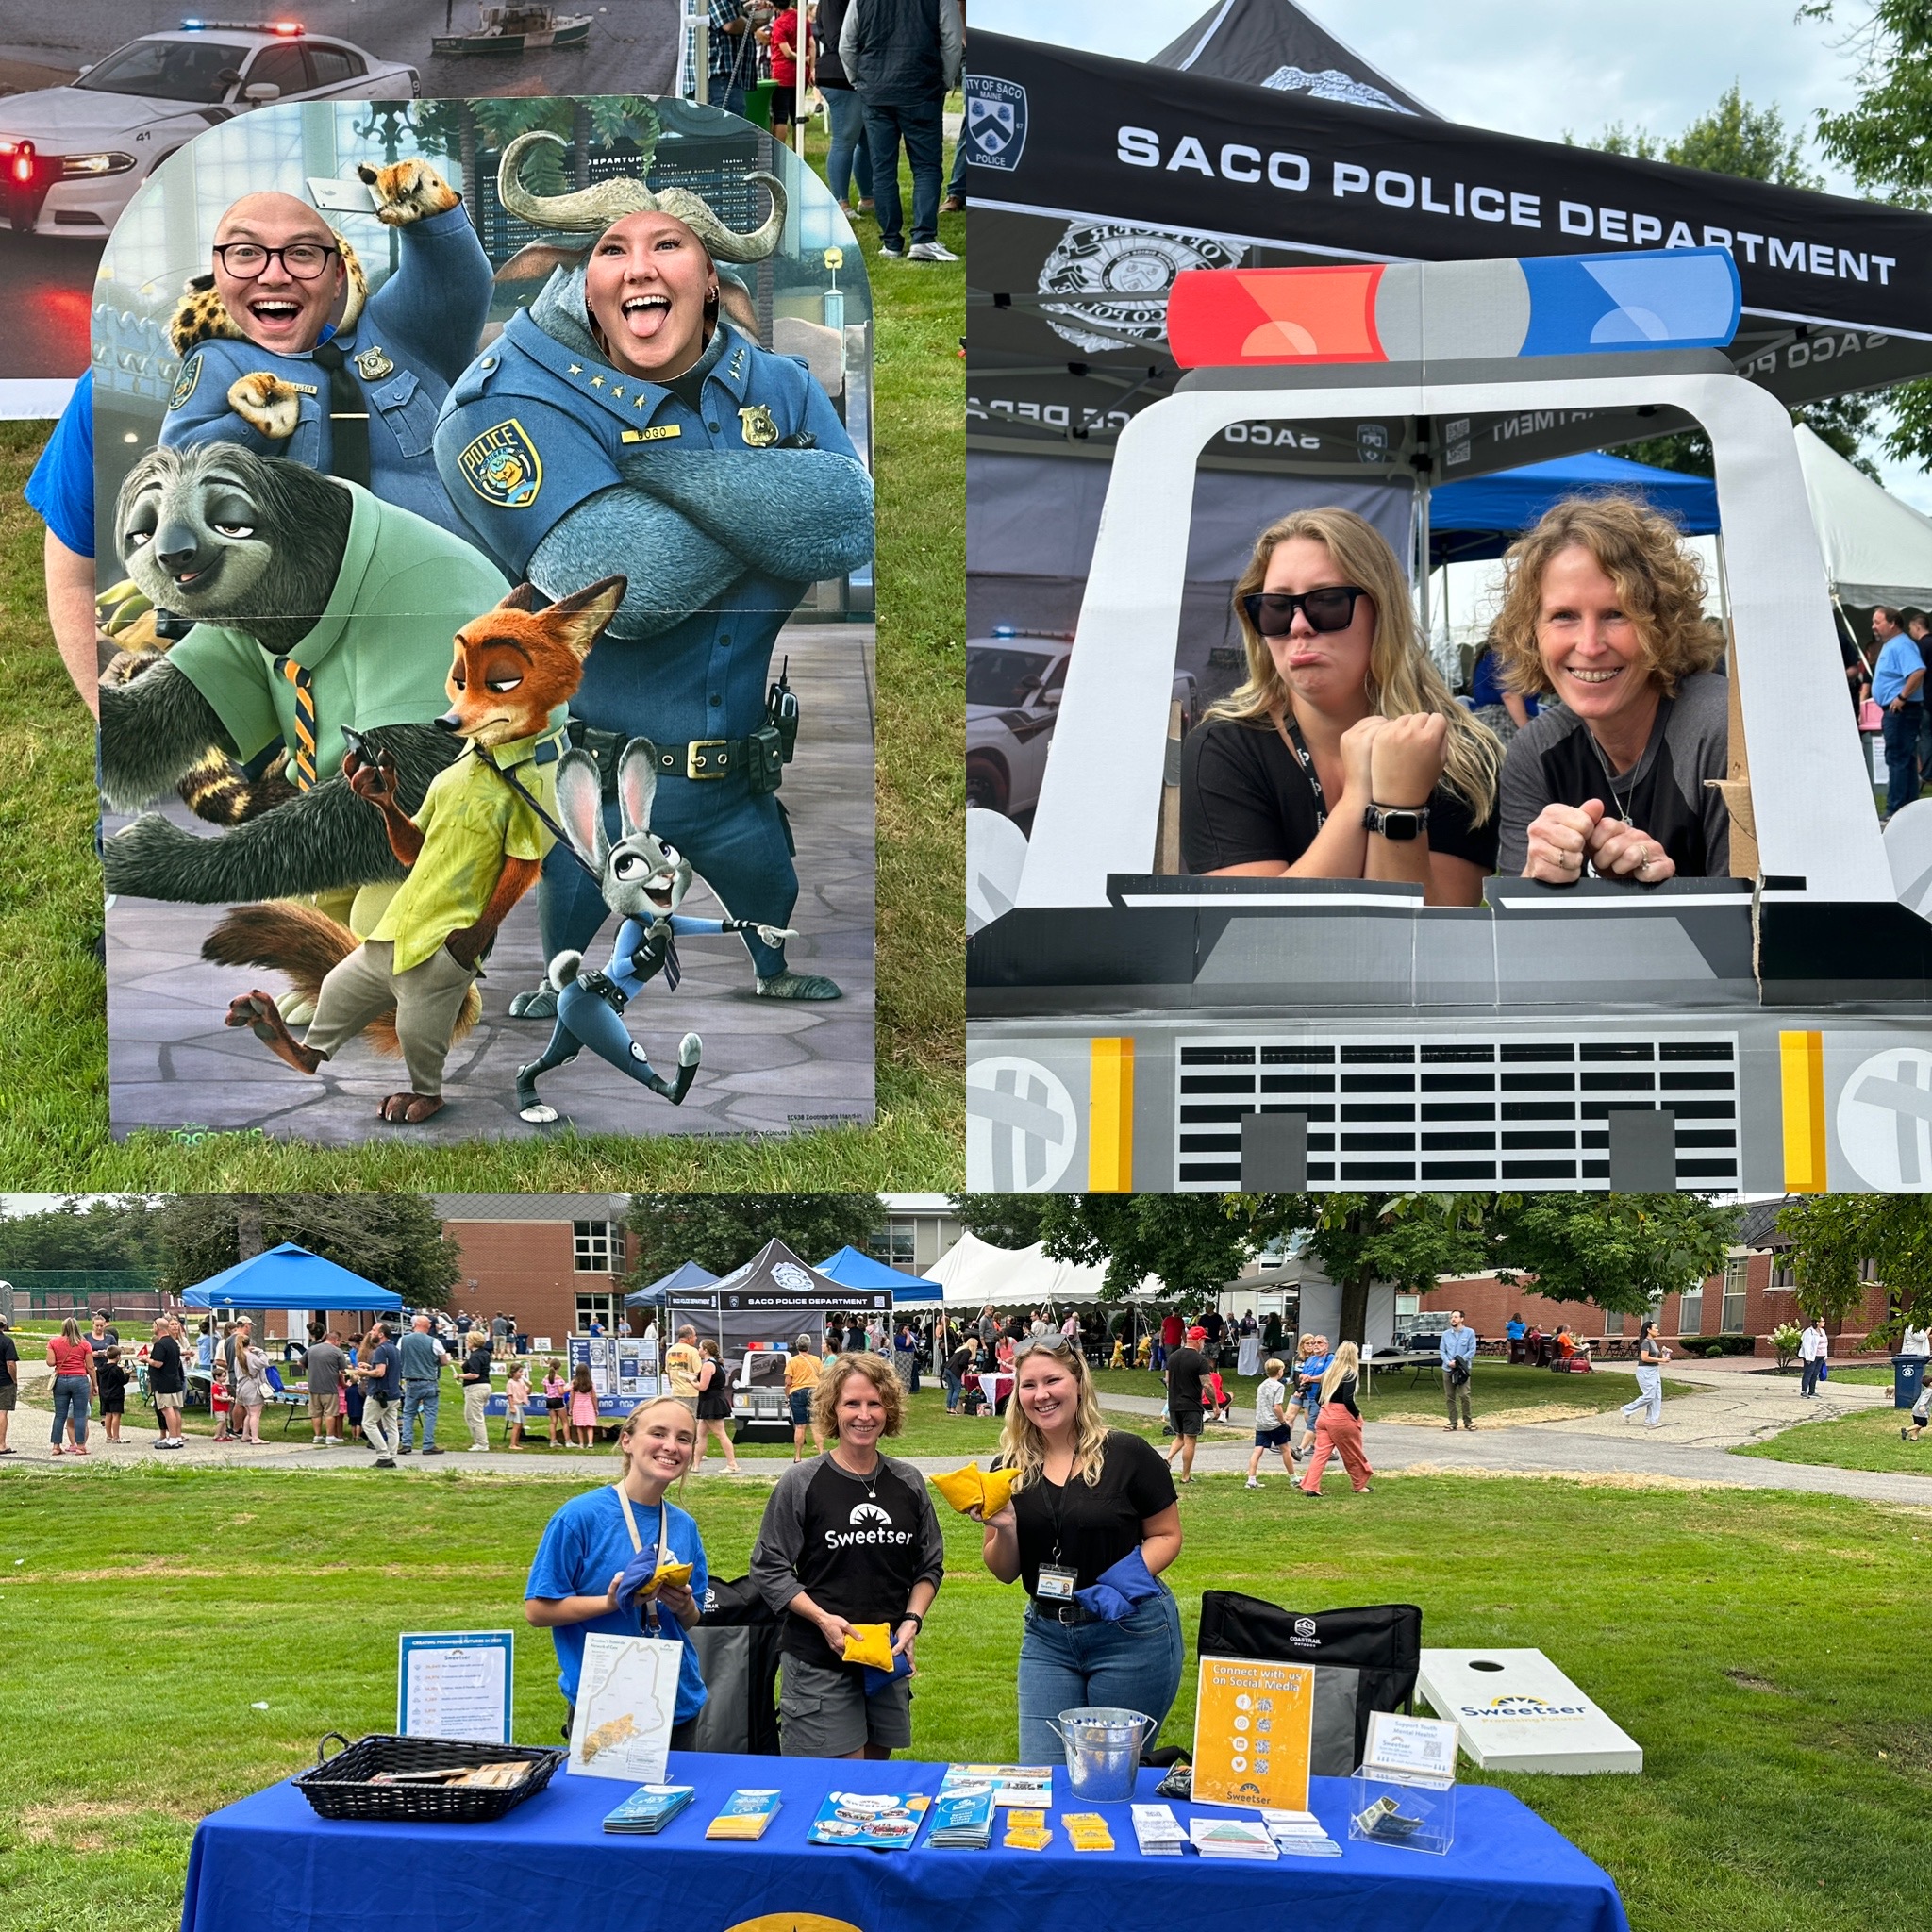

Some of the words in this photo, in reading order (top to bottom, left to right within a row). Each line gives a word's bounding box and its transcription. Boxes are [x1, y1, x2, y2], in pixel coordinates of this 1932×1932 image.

[980, 91, 1003, 101] MAINE
[982, 80, 994, 91] OF
[996, 83, 1023, 99] SACO
[136, 131, 151, 142] 41
[976, 154, 1006, 166] POLICE
[1117, 125, 1310, 192] SACO
[1333, 160, 1542, 229] POLICE
[1558, 199, 1897, 286] DEPARTMENT
[637, 426, 667, 441] BOGO
[462, 425, 519, 480] POLICE
[824, 1526, 914, 1550] Sweetser
[1212, 1664, 1257, 1677] Connect
[1261, 1667, 1285, 1679] with
[1289, 1673, 1302, 1681] us
[1229, 1675, 1262, 1688] Social
[1264, 1680, 1300, 1691] Media
[1461, 1706, 1587, 1717] Sweetser
[1395, 1721, 1419, 1730] Support
[1420, 1724, 1438, 1732] Youth
[1382, 1740, 1411, 1750] Sweetser
[1226, 1790, 1272, 1805] Sweetser
